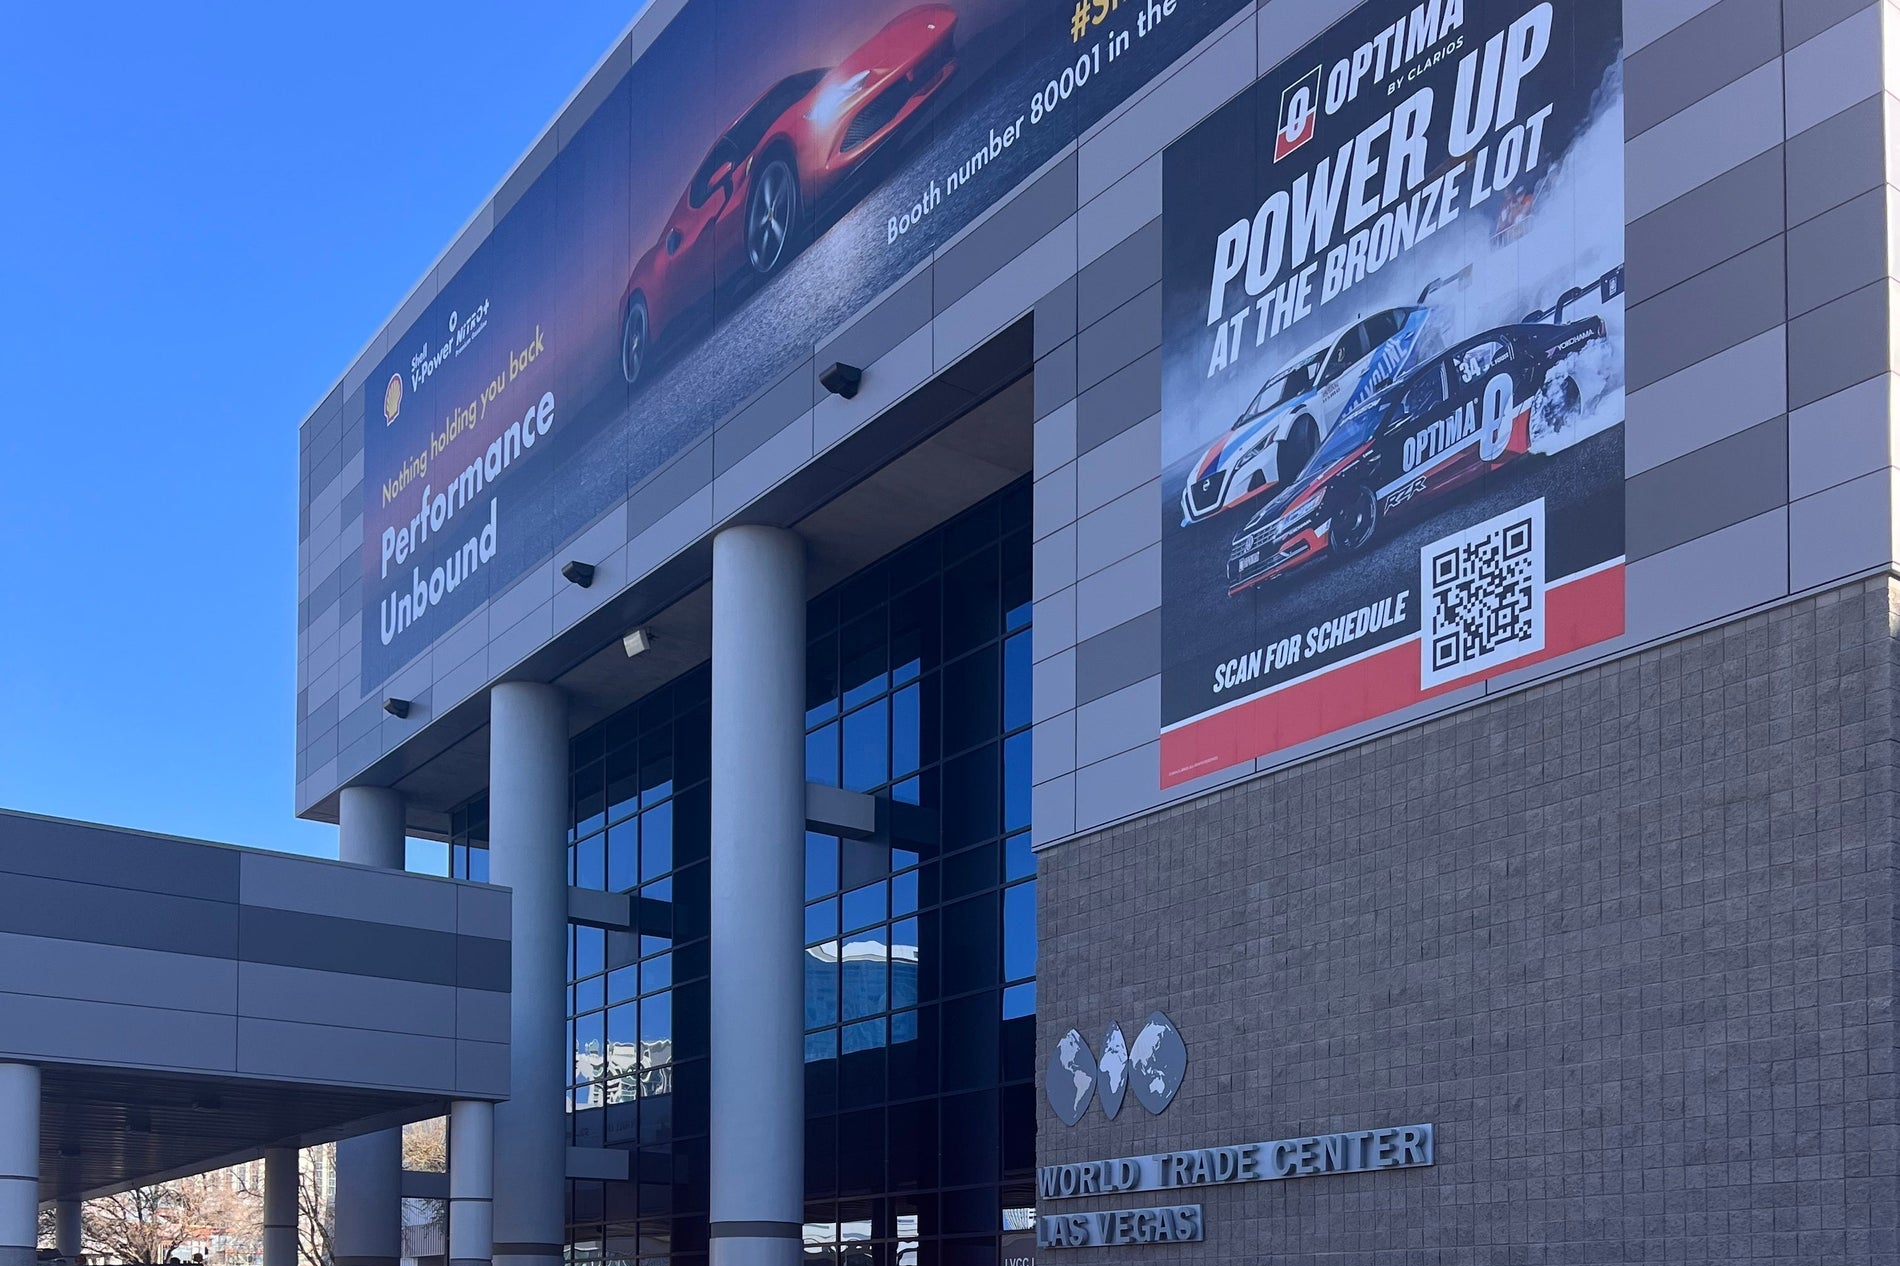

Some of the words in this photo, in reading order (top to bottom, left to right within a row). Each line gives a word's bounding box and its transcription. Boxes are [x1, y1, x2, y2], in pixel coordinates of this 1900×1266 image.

[1325, 0, 1465, 116] OPTIMA
[1387, 77, 1405, 96] BY
[1407, 35, 1465, 83] CLARIOS
[887, 181, 941, 245] Booth
[946, 115, 1024, 196] number
[1030, 43, 1100, 125] 80001
[1108, 30, 1130, 63] in
[1137, 0, 1178, 38] the
[1206, 86, 1435, 327] POWER
[1448, 1, 1554, 158] UP
[1207, 306, 1253, 379] AT
[1255, 260, 1318, 348] THE
[1320, 162, 1468, 306] BRONZE
[1469, 103, 1554, 209] LOT
[381, 449, 428, 509] Nothing
[430, 402, 478, 461] holding
[479, 371, 506, 420] you
[509, 324, 545, 383] back
[411, 337, 454, 393] V-Power
[1459, 357, 1482, 384] 34
[381, 391, 556, 580] Performance
[1402, 400, 1477, 473] OPTIMA
[380, 498, 498, 646] Unbound
[1212, 650, 1262, 694] SCAN
[1263, 633, 1301, 675] FOR
[1304, 590, 1410, 659] SCHEDULE
[1037, 1157, 1140, 1198] WORLD
[1151, 1143, 1259, 1187] TRADE
[1270, 1125, 1428, 1177] CENTER
[1037, 1213, 1088, 1248] LAS
[1098, 1206, 1197, 1244] VEGAS
